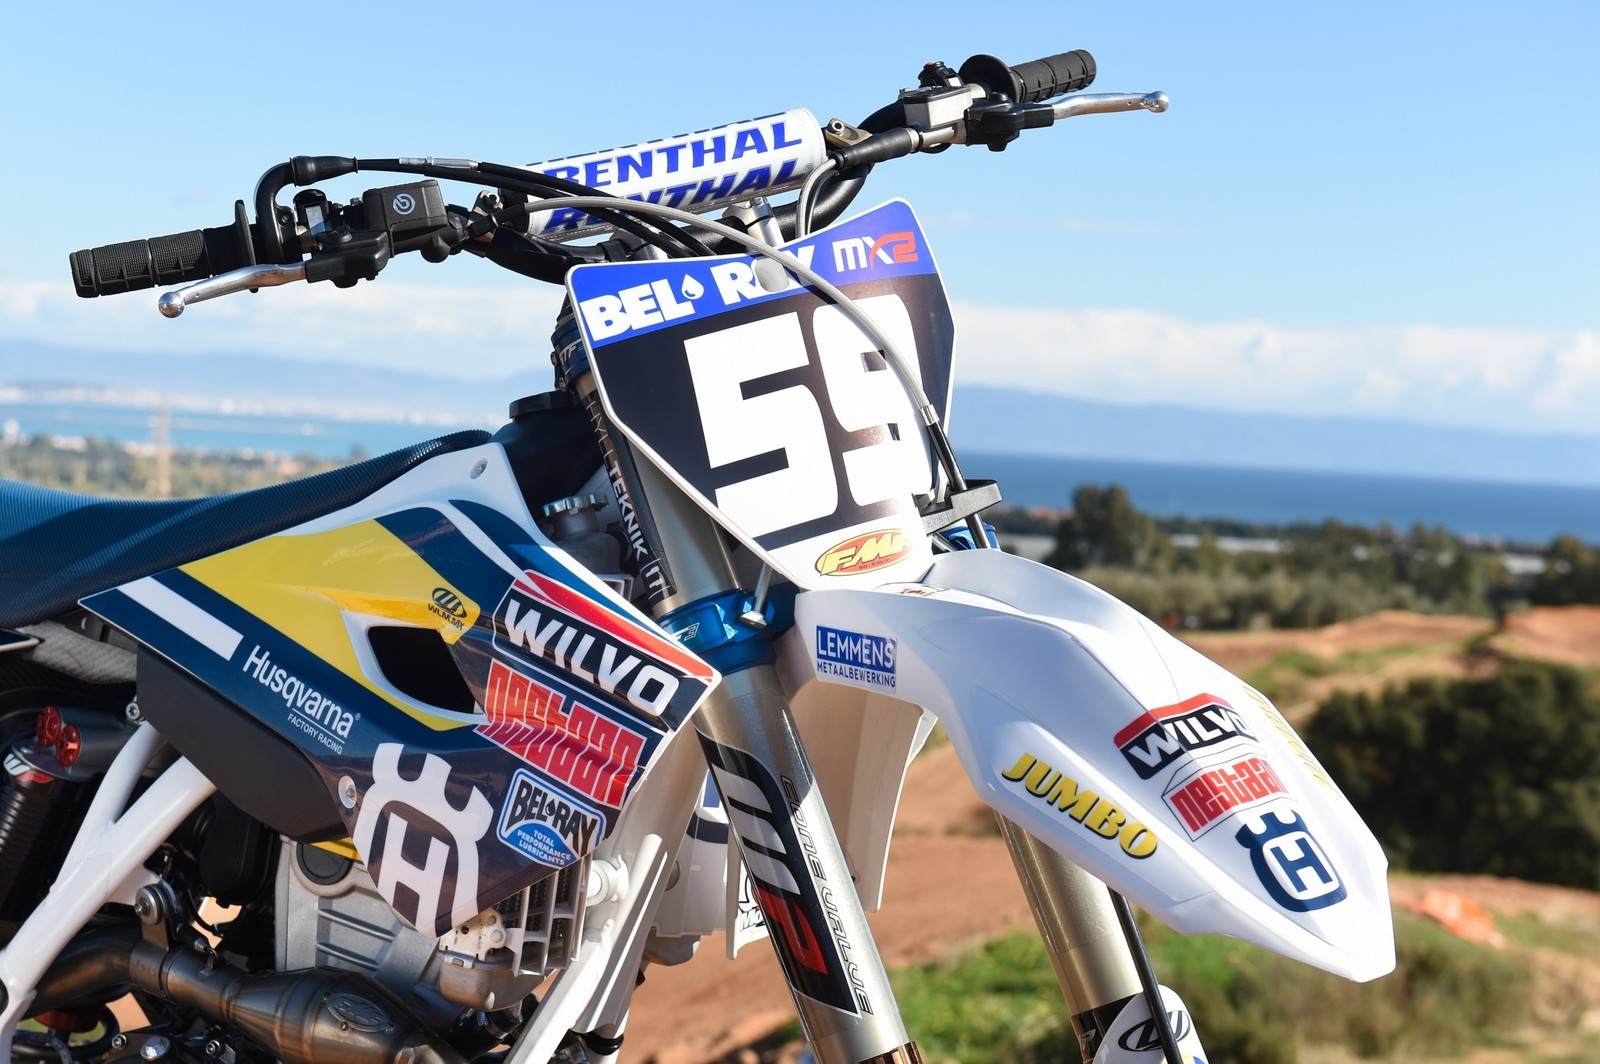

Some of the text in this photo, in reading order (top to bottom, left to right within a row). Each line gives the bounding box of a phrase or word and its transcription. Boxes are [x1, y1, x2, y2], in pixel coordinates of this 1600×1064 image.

[543, 158, 798, 233] RNTHAL
[832, 231, 919, 273] MX2
[579, 279, 696, 342] BEL
[683, 293, 933, 539] 59
[504, 598, 680, 717] WILVO
[817, 629, 896, 669] LEMMENS
[817, 660, 896, 688] METAALBEWERKING
[242, 644, 356, 740] Husqvarna
[287, 713, 343, 756] FACTORY RACING
[1128, 707, 1252, 769] WILVO
[1001, 752, 1158, 860] JUMBO
[517, 829, 572, 861] PERFORMANCE
[518, 840, 566, 866] LUBRICANTS
[533, 830, 555, 848] TOTAL
[780, 774, 874, 1016] CONE VALVE
